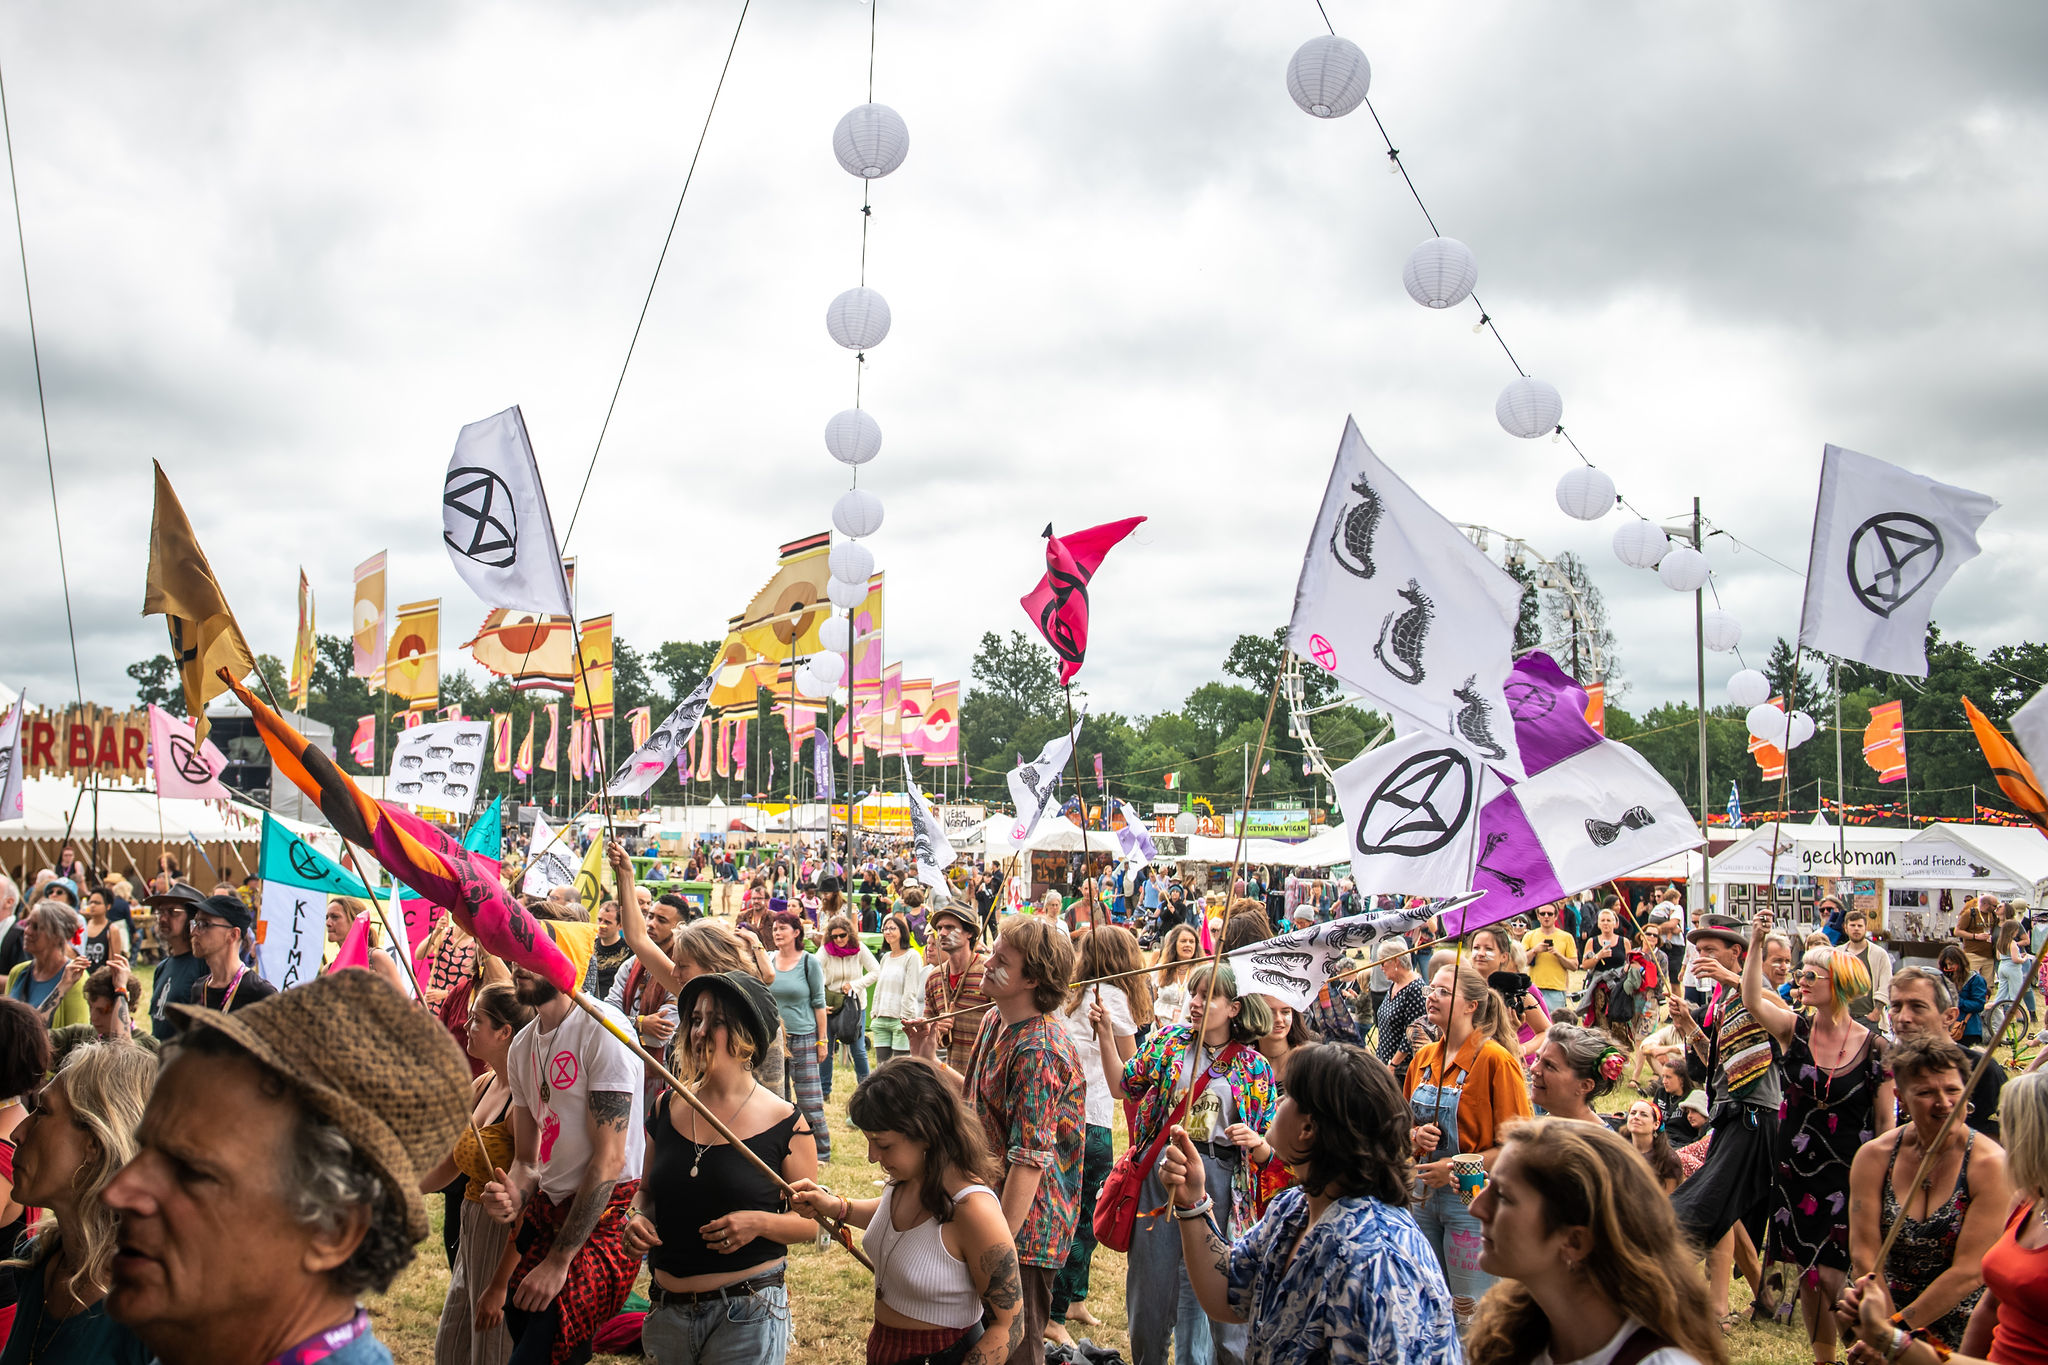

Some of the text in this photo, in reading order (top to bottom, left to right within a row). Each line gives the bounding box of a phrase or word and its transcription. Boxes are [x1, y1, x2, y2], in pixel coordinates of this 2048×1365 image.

[68, 723, 146, 770] BAR
[1802, 842, 1897, 873] geckoman
[1932, 855, 1967, 867] friends
